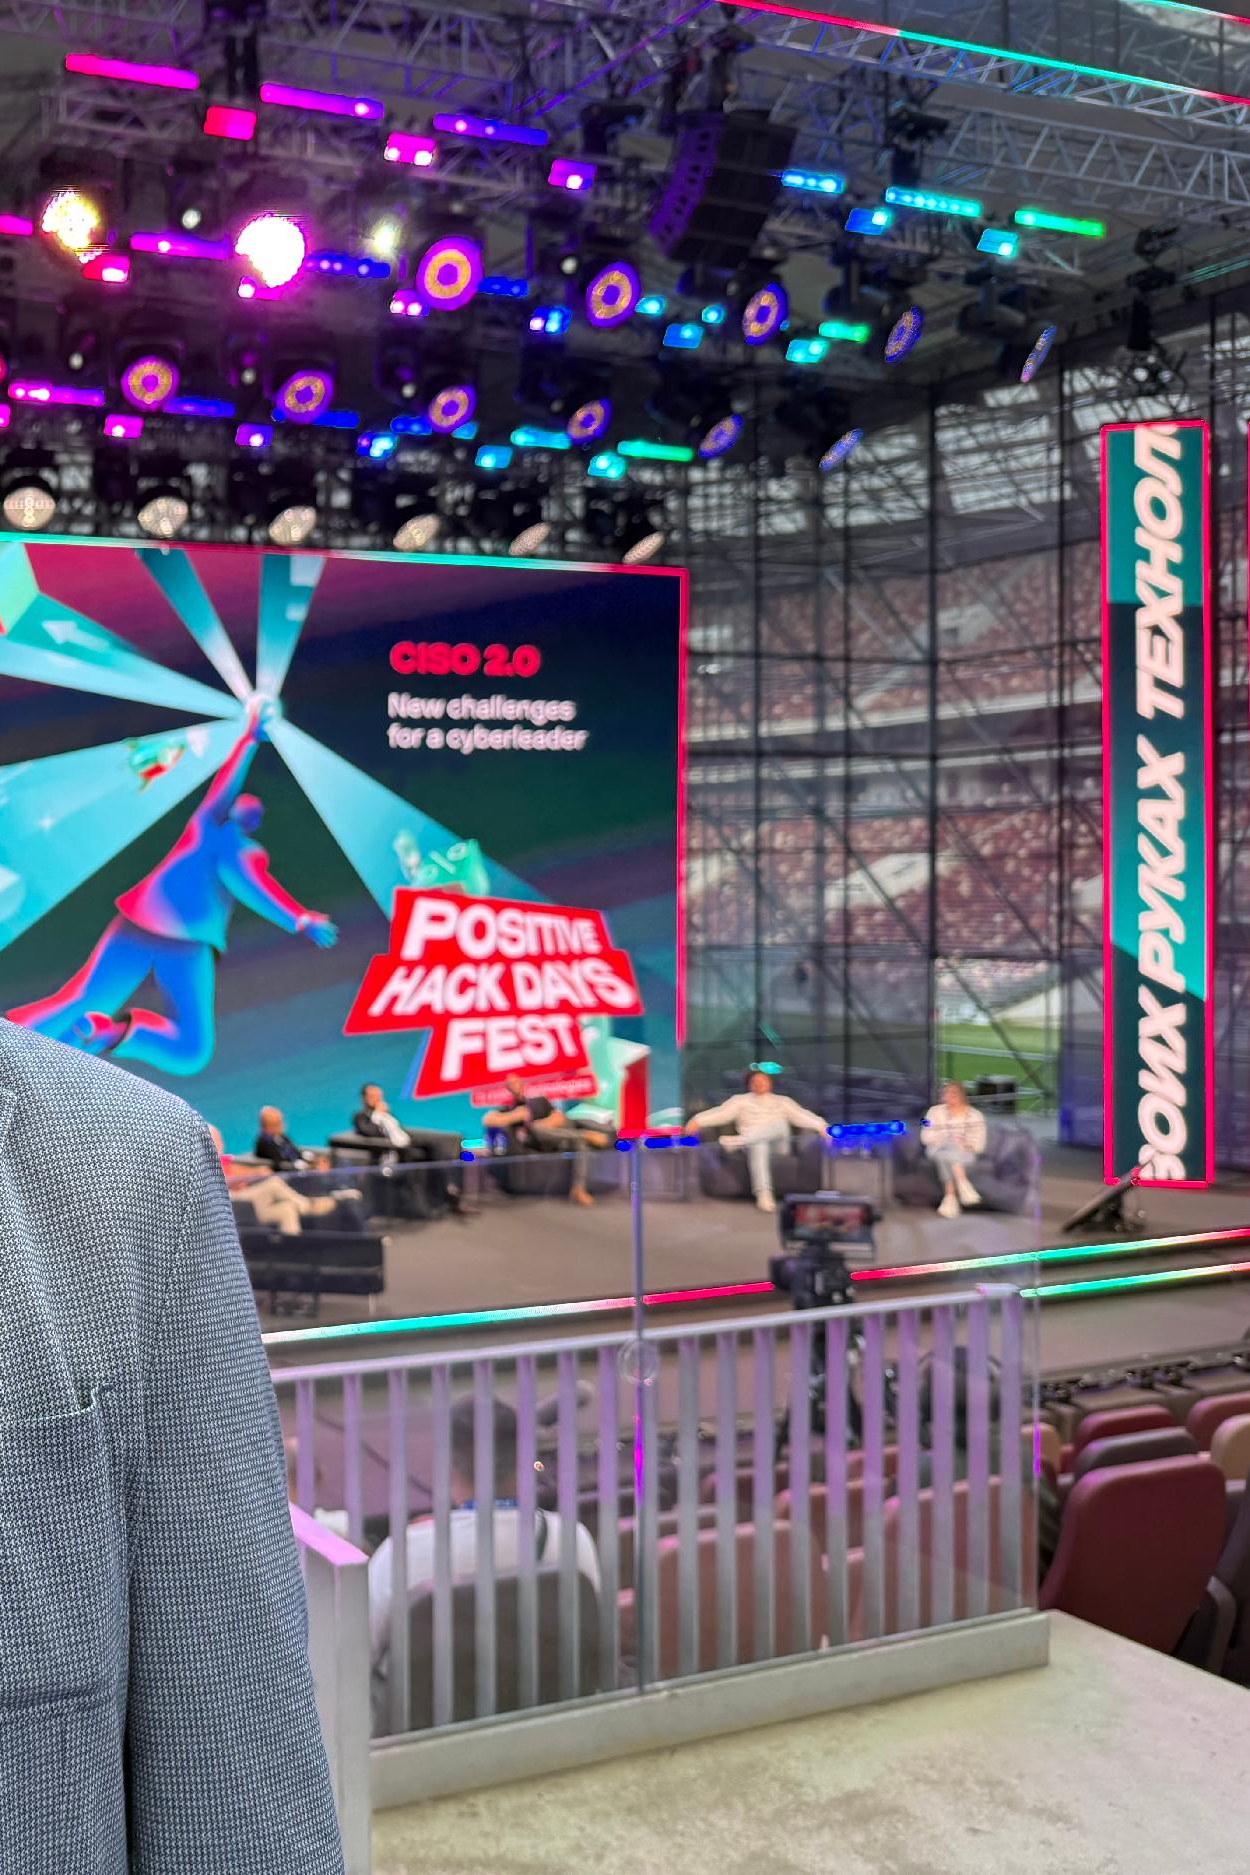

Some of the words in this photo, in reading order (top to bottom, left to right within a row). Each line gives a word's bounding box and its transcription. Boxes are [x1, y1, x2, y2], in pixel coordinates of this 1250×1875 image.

[1134, 424, 1185, 719] ТЕХНОЛ
[389, 641, 480, 676] CISO
[483, 643, 541, 677] 2.0
[387, 692, 447, 719] New
[446, 694, 577, 727] challenges
[387, 723, 425, 749] for
[426, 727, 446, 749] a
[446, 724, 590, 755] cyberleader
[1137, 734, 1186, 993] РУКАХ
[400, 896, 602, 961] POSITIVE
[367, 960, 511, 1017] HACK
[511, 957, 637, 1009] DAYS
[440, 1012, 579, 1082] FEST
